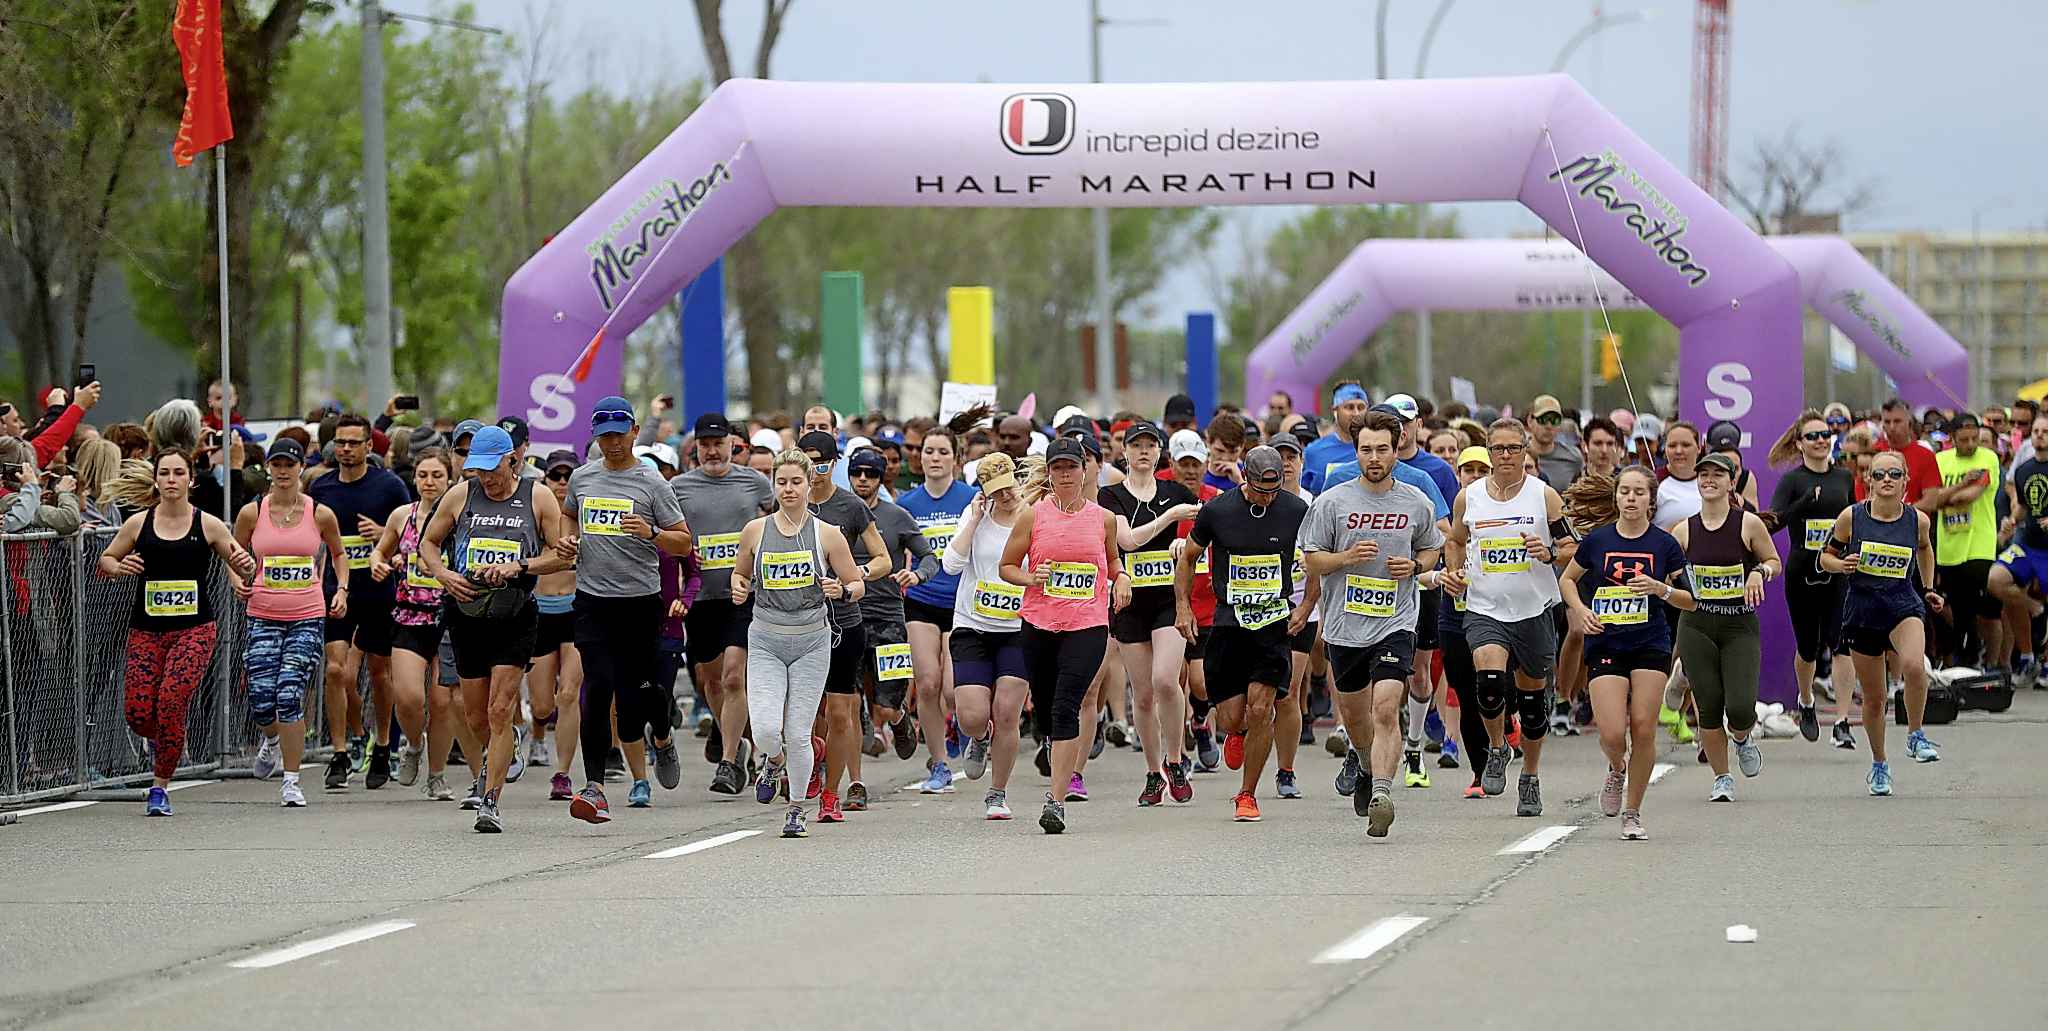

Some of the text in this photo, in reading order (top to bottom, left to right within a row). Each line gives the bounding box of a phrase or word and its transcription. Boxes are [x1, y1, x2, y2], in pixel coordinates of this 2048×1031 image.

[1086, 126, 1320, 157] intrepid dezine
[915, 170, 1378, 194] HALF MARATHON
[1548, 154, 1710, 287] Marathon
[590, 161, 732, 311] Marathon
[469, 513, 523, 529] fresh air
[1346, 512, 1409, 530] SPEED
[476, 549, 515, 565] 7031
[707, 543, 740, 560] 735
[1487, 548, 1528, 564] 6247
[1134, 560, 1172, 577] 8019
[1867, 552, 1908, 570] 7959
[271, 566, 313, 581] 8578
[769, 562, 811, 579] 7142
[1237, 565, 1278, 580] 6367
[1053, 572, 1094, 589] 7106
[1702, 575, 1742, 590] 6547
[153, 591, 195, 606] 6424
[981, 592, 1021, 611] 6126
[1353, 588, 1394, 606] 8296
[1601, 598, 1644, 614] 7077
